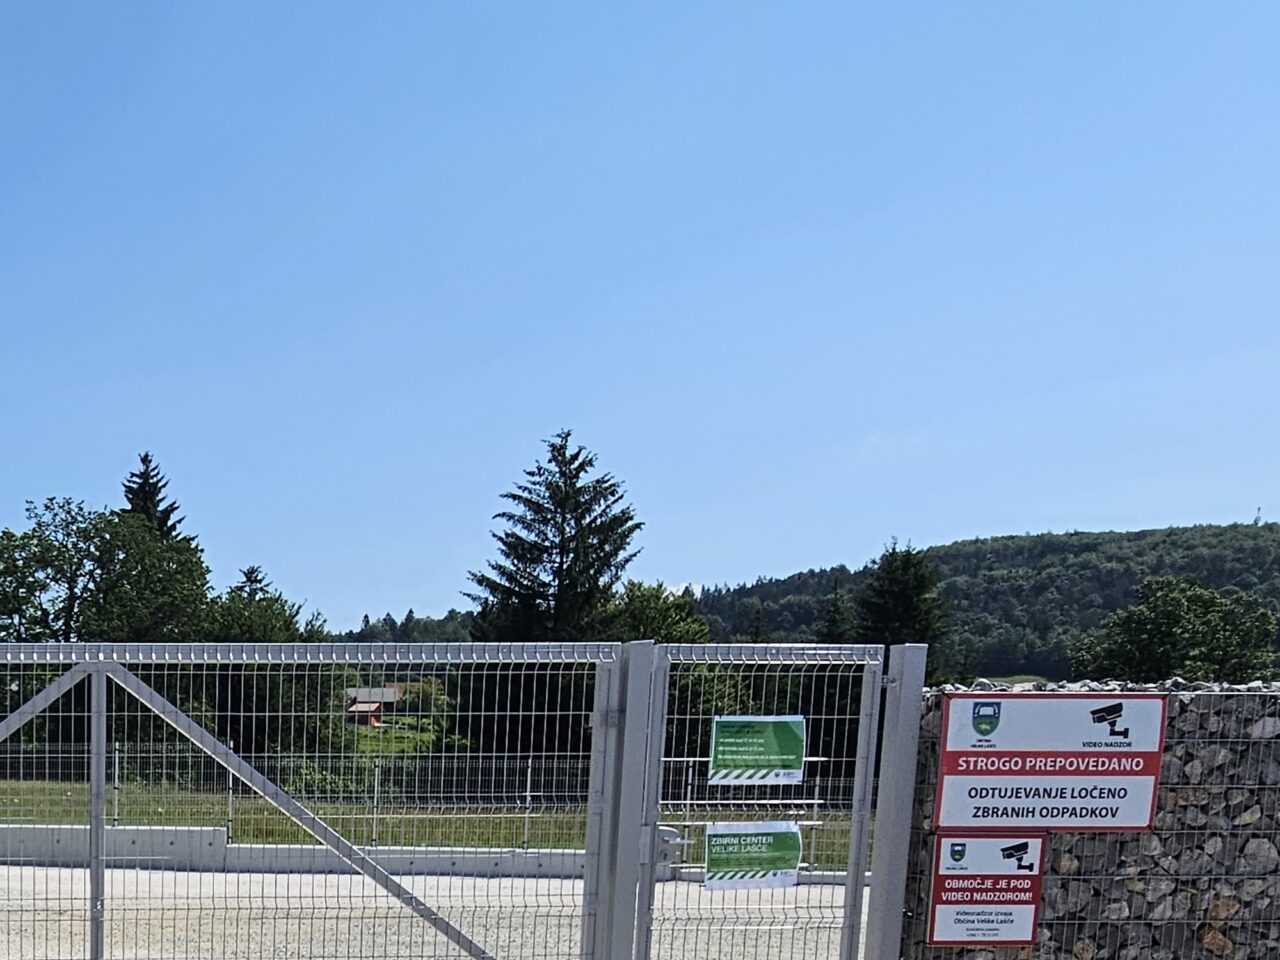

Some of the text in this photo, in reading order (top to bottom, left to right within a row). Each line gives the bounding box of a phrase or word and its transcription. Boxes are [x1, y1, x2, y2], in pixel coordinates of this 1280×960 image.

[958, 757, 1144, 771] STROGO PREPOVEDANO
[967, 784, 1128, 799] ODTUJEVANJE LOČENO
[972, 806, 1119, 819] ZBRANIH ODPADKOV
[711, 836, 773, 845] ZBIRNI CENTER
[711, 845, 740, 853] VELIKE
[944, 877, 1031, 889] OBMOČJE JE POD
[941, 892, 1033, 901] VIDEO NADZOROM!
